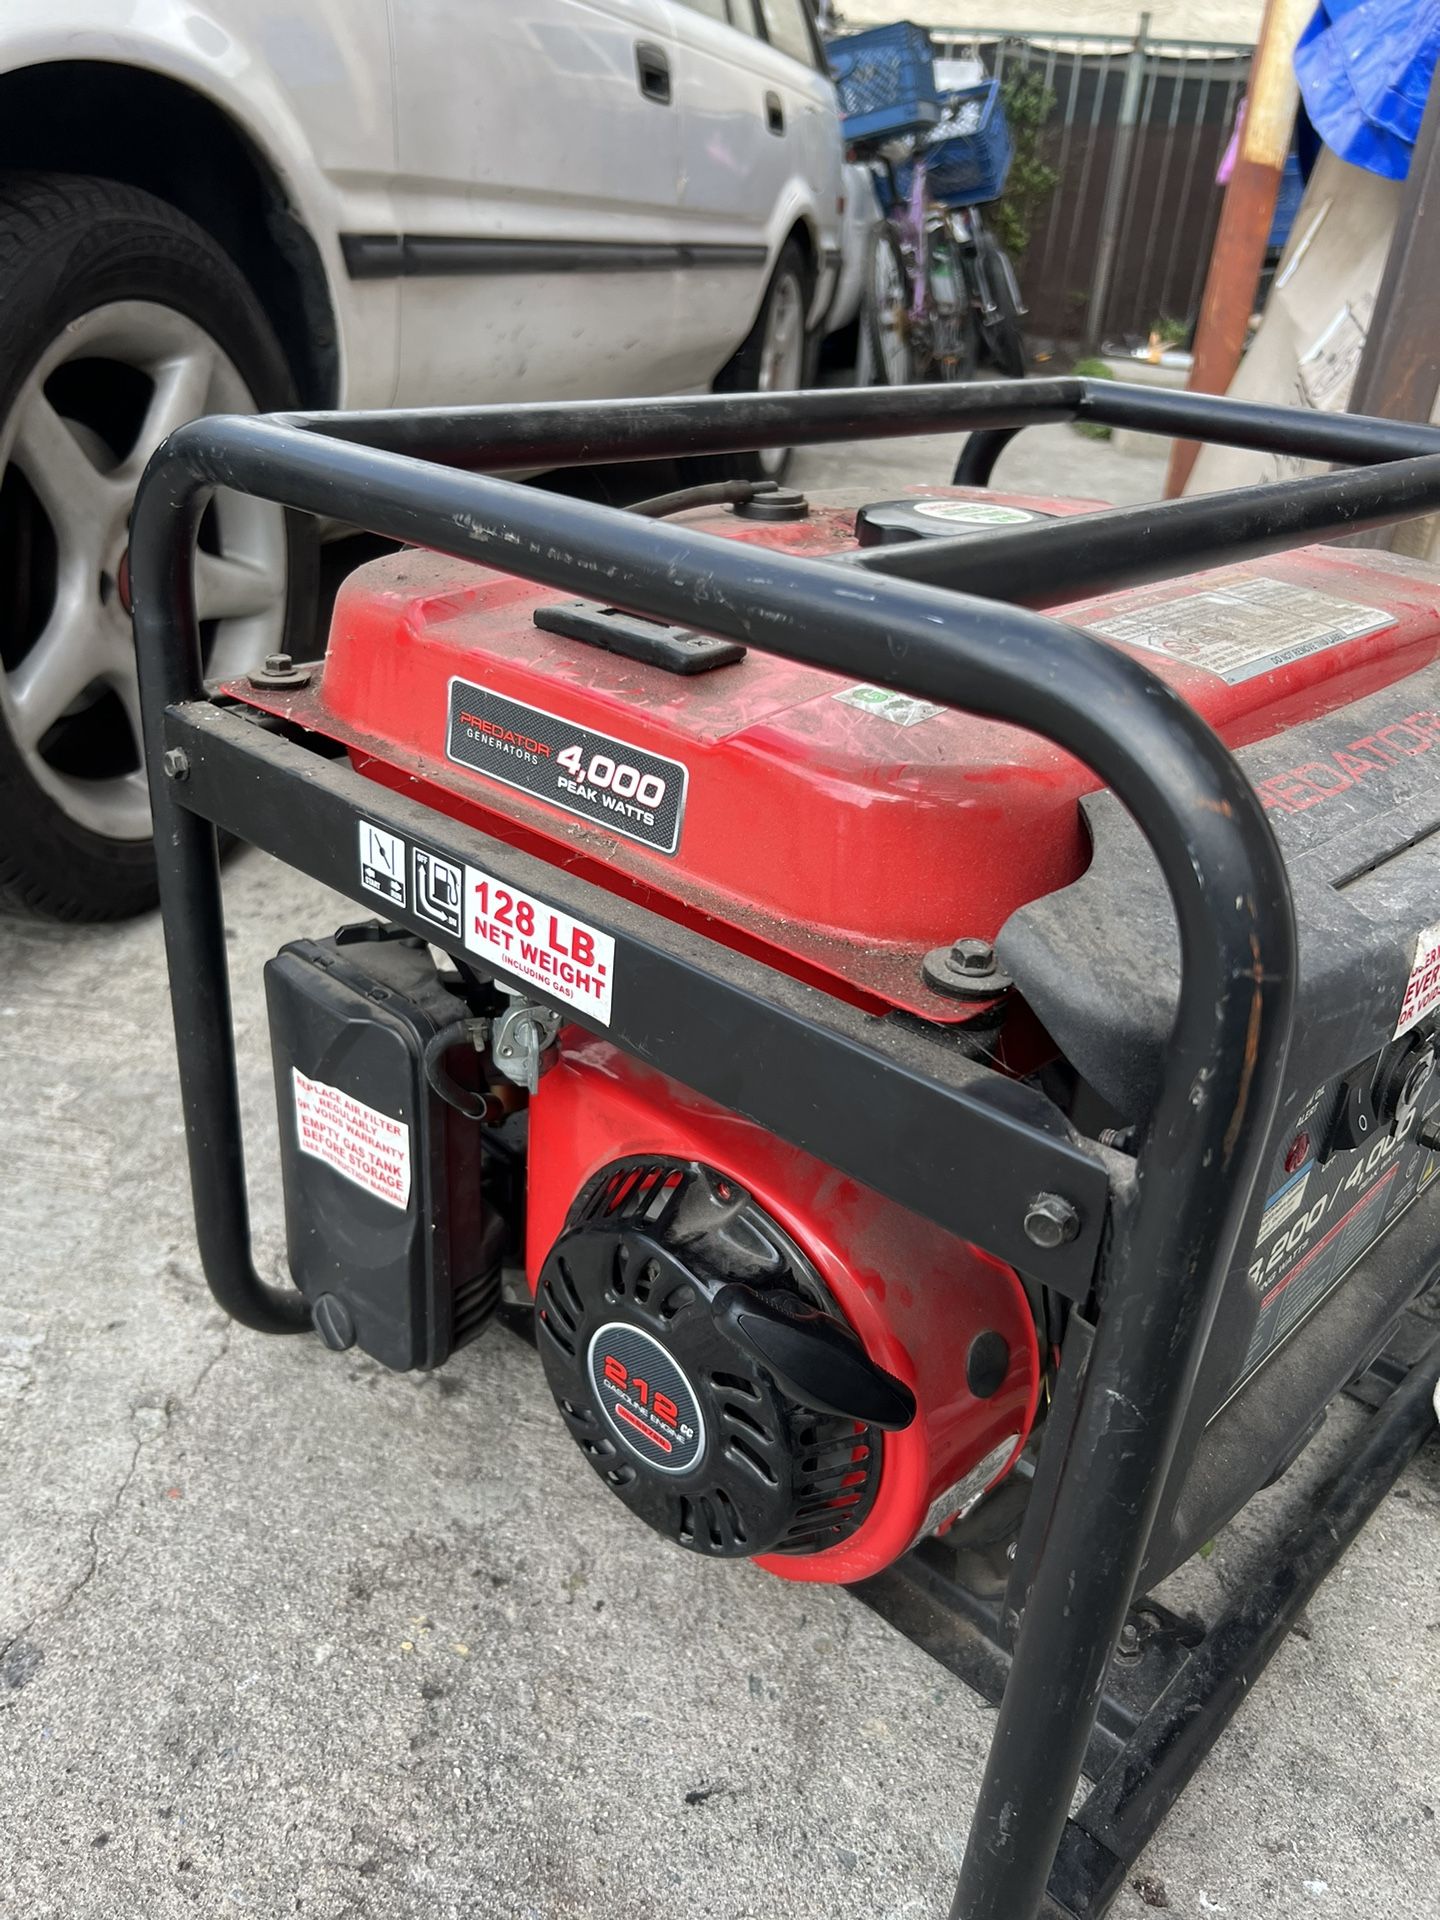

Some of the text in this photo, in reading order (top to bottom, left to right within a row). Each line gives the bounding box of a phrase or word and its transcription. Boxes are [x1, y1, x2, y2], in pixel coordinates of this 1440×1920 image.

[460, 711, 551, 758] PREDATOR
[467, 729, 538, 765] GENERATORS
[1253, 711, 1440, 815] EDATOR
[556, 745, 666, 809] 4,000
[558, 776, 655, 826] PEAK WATTS
[475, 881, 607, 976] 128 LB.
[475, 916, 606, 999] NET WEIGHT
[502, 953, 574, 999] (INCLUDING GAS)
[1399, 1006, 1414, 1025] OR
[297, 1076, 402, 1136] REPLACE AIR FILTER
[298, 1098, 405, 1161] OR VOIDS WARRANTY
[319, 1098, 378, 1136] REGULARLY
[301, 1115, 402, 1178] EMPTY GAS TANK
[303, 1127, 404, 1191] BEFORE STORAGE
[322, 1149, 369, 1184] INSTRUCTION
[603, 1379, 648, 1417] GASOLINE
[650, 1414, 685, 1444] ENGINE
[604, 1355, 678, 1428] 212
